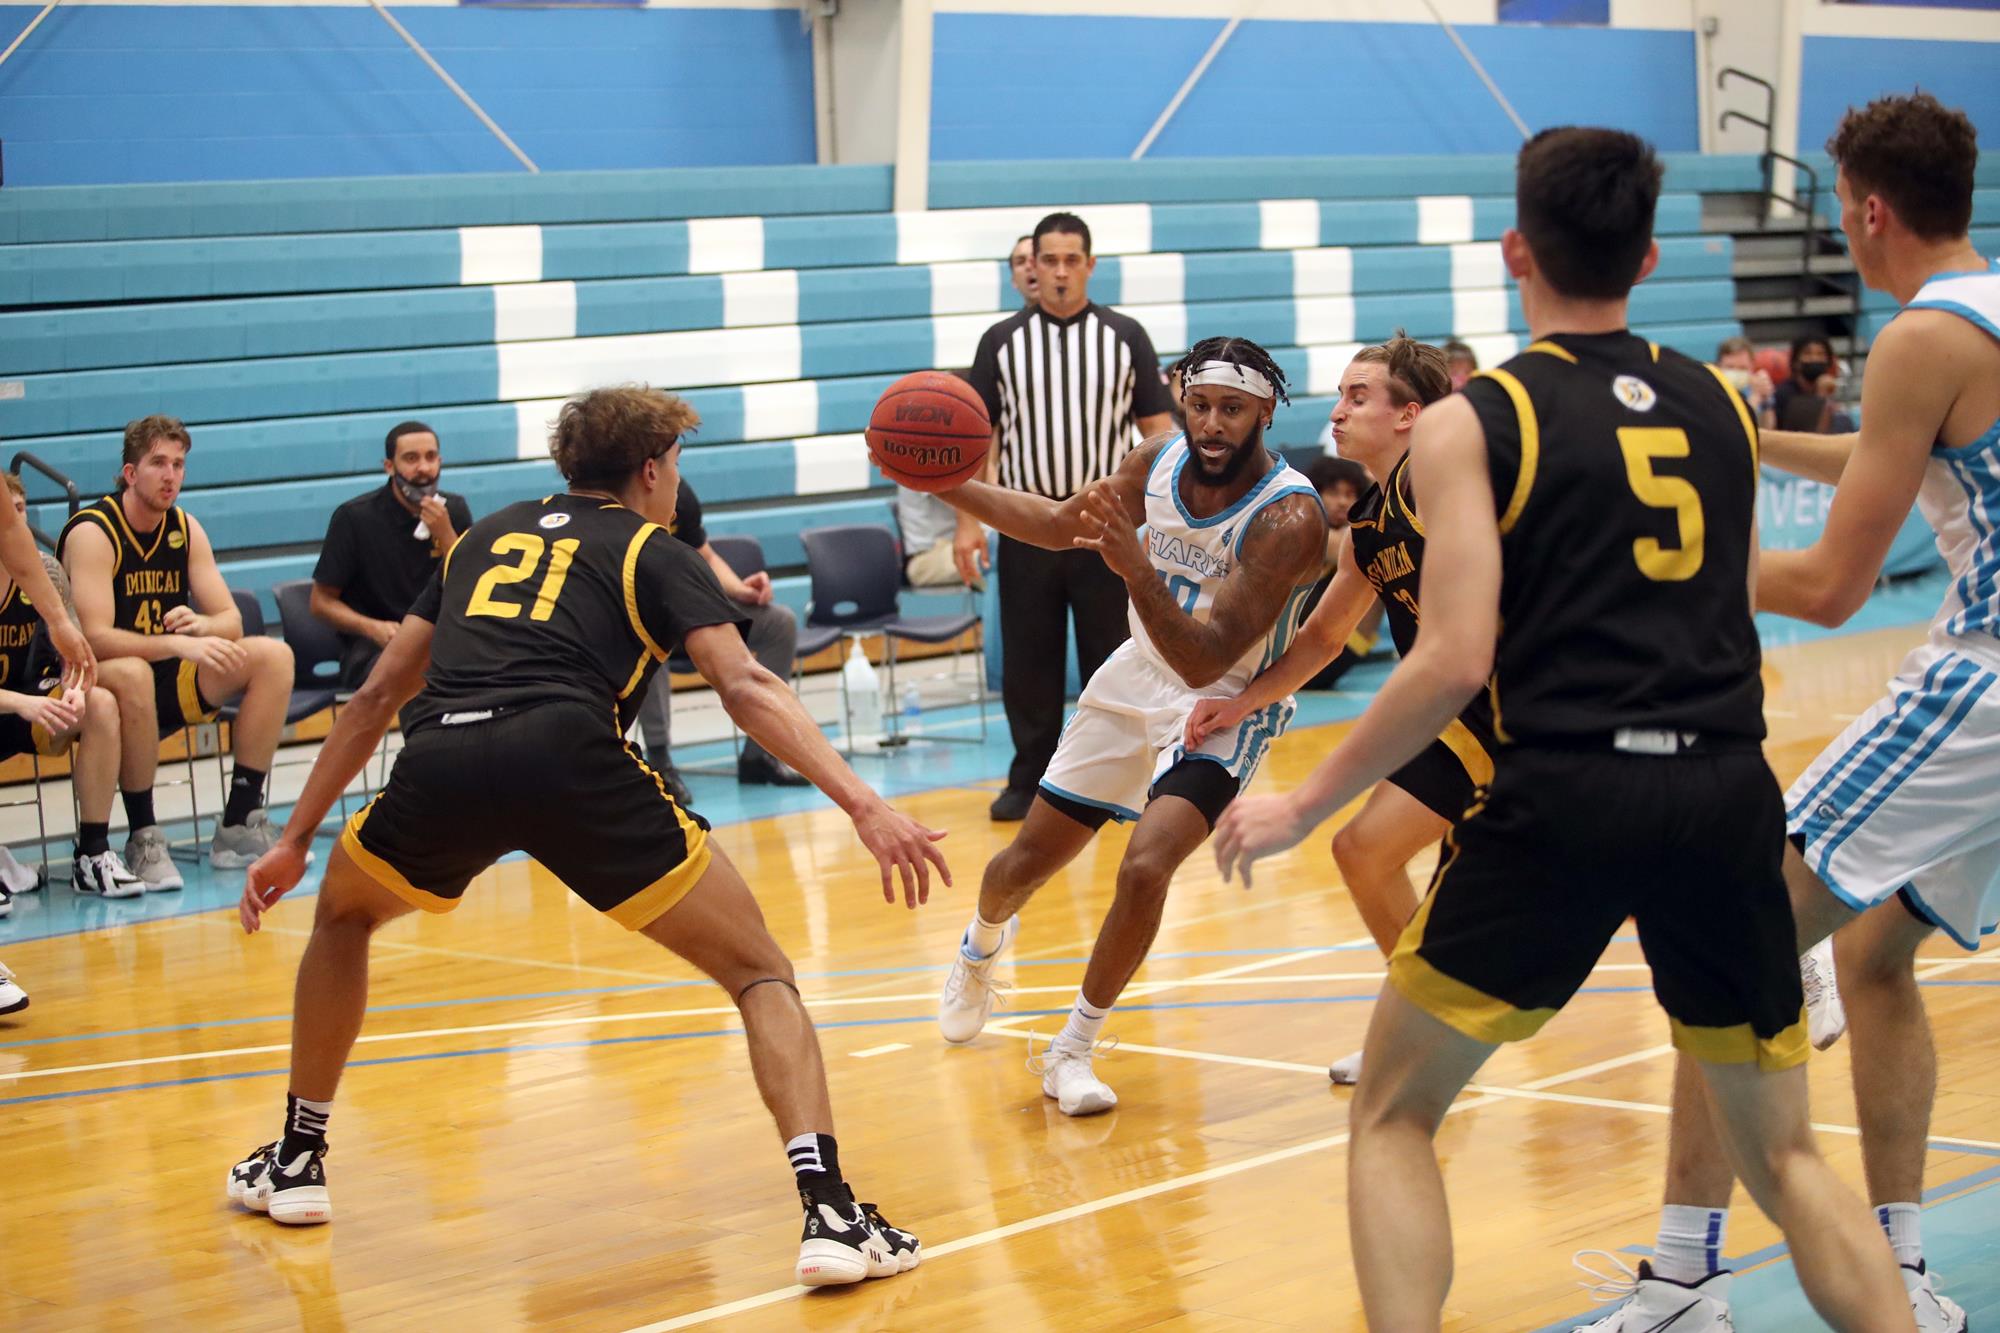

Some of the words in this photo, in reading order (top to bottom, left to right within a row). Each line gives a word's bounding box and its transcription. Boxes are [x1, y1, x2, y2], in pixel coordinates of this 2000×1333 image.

[883, 439, 961, 466] Wilson
[1615, 426, 1705, 582] 5
[464, 531, 581, 622] 21
[134, 599, 164, 635] 43
